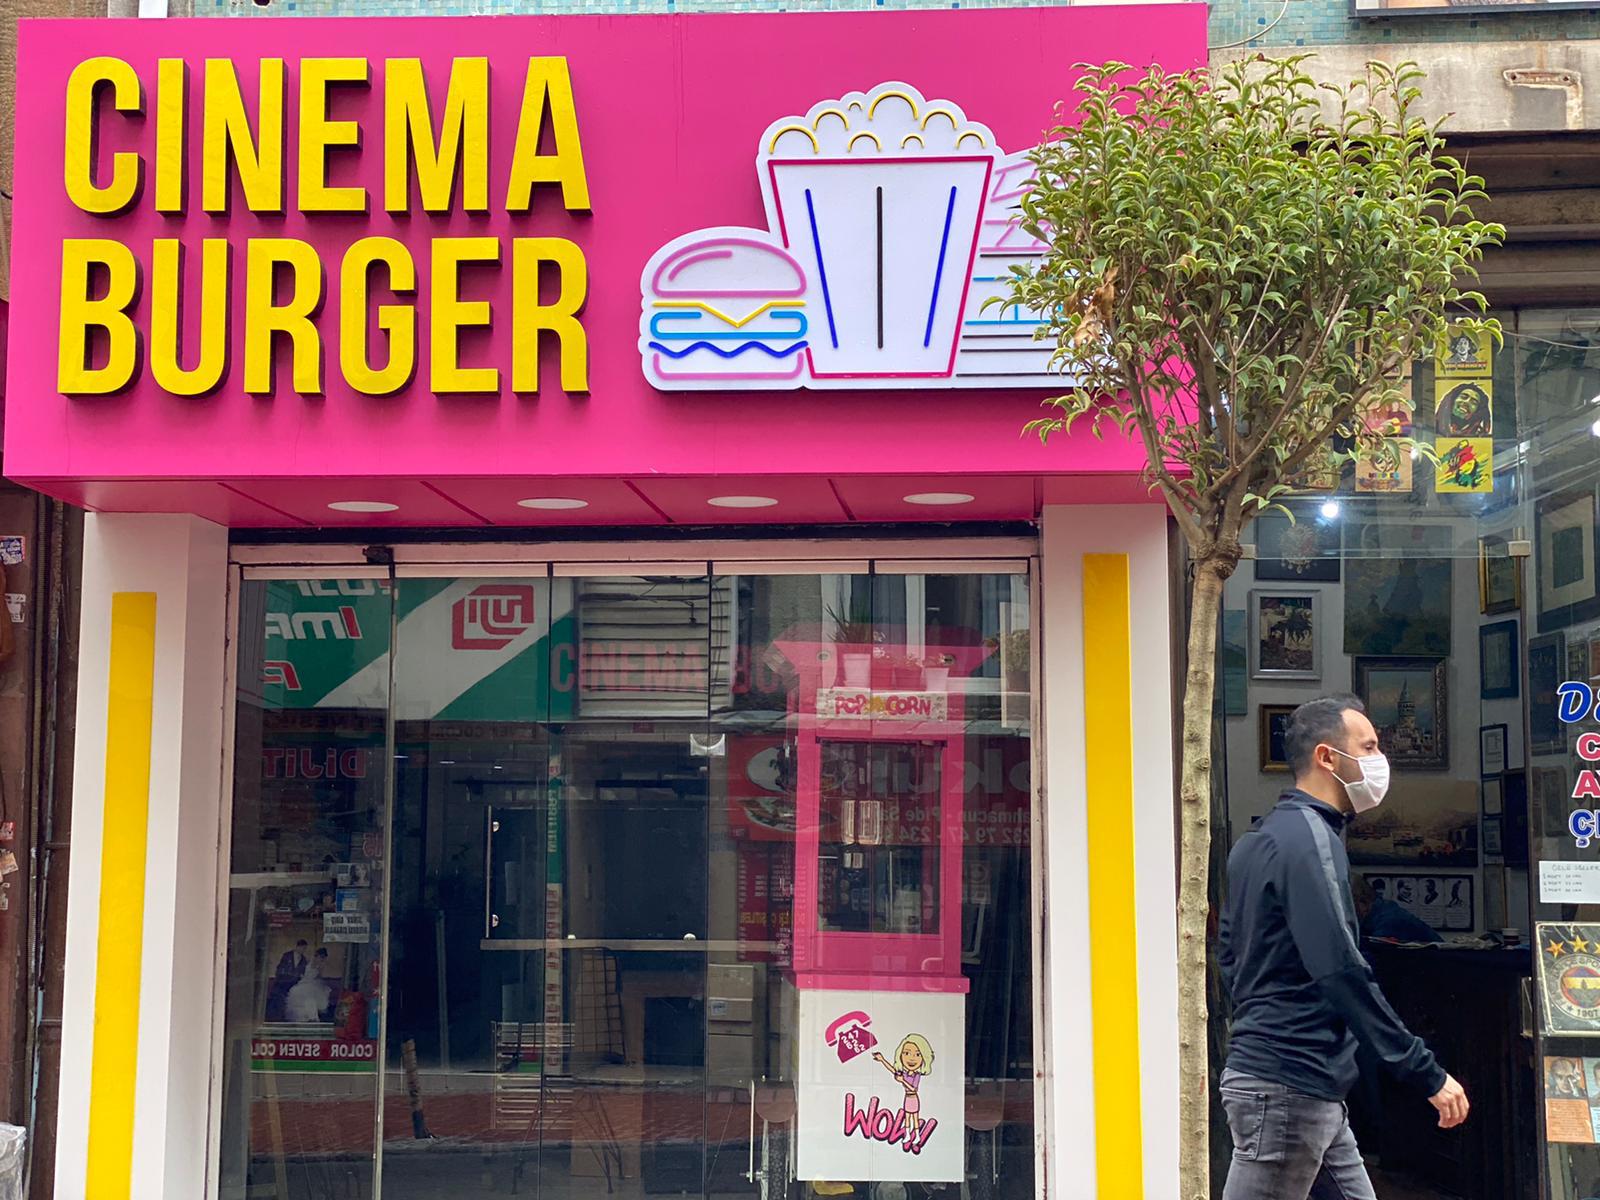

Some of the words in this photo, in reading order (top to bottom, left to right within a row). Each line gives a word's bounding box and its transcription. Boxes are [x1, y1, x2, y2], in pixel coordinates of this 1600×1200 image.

[64, 55, 592, 215] CINEMA
[57, 236, 591, 397] BURGER
[884, 695, 931, 716] CORN
